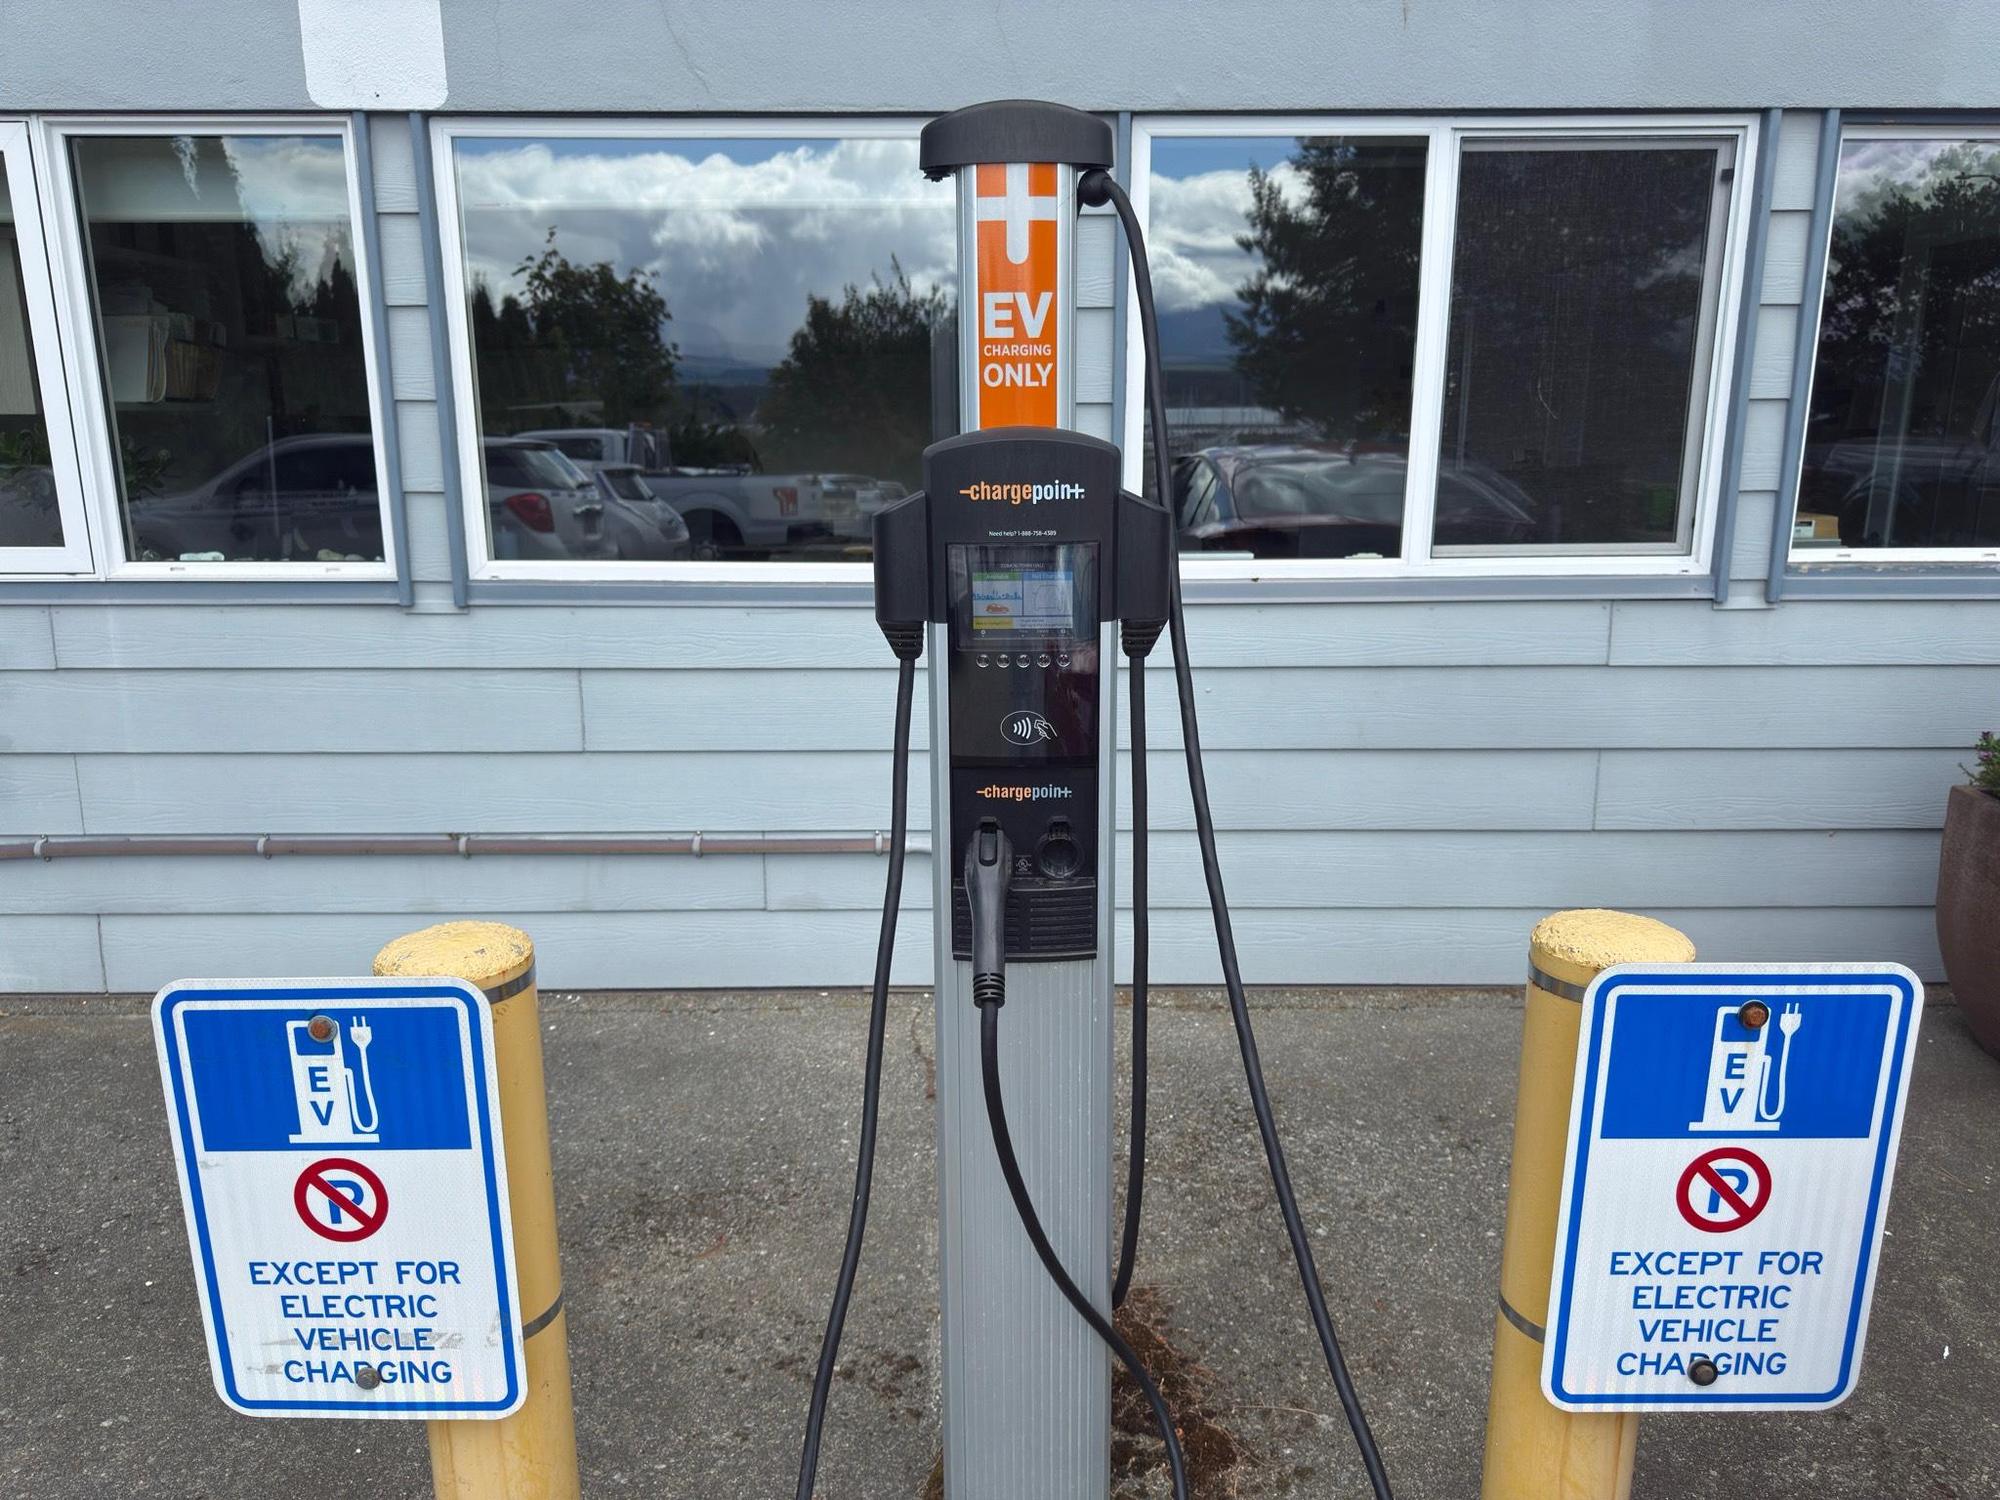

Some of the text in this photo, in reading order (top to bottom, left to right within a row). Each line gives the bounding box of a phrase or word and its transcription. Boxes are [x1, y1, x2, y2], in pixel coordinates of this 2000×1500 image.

[984, 292, 1053, 338] EV
[984, 345, 1051, 356] CHARGING
[983, 363, 1052, 387] ONLY
[1003, 530, 1017, 538] help?
[249, 1260, 461, 1285] EXCEPT FOR
[1609, 1250, 1823, 1276] EXCEPT FOR
[281, 1294, 438, 1319] ELECTRIC
[1632, 1284, 1791, 1310] ELECTRIC
[294, 1327, 434, 1352] VEHICLE
[1639, 1317, 1779, 1343] VEHICLE
